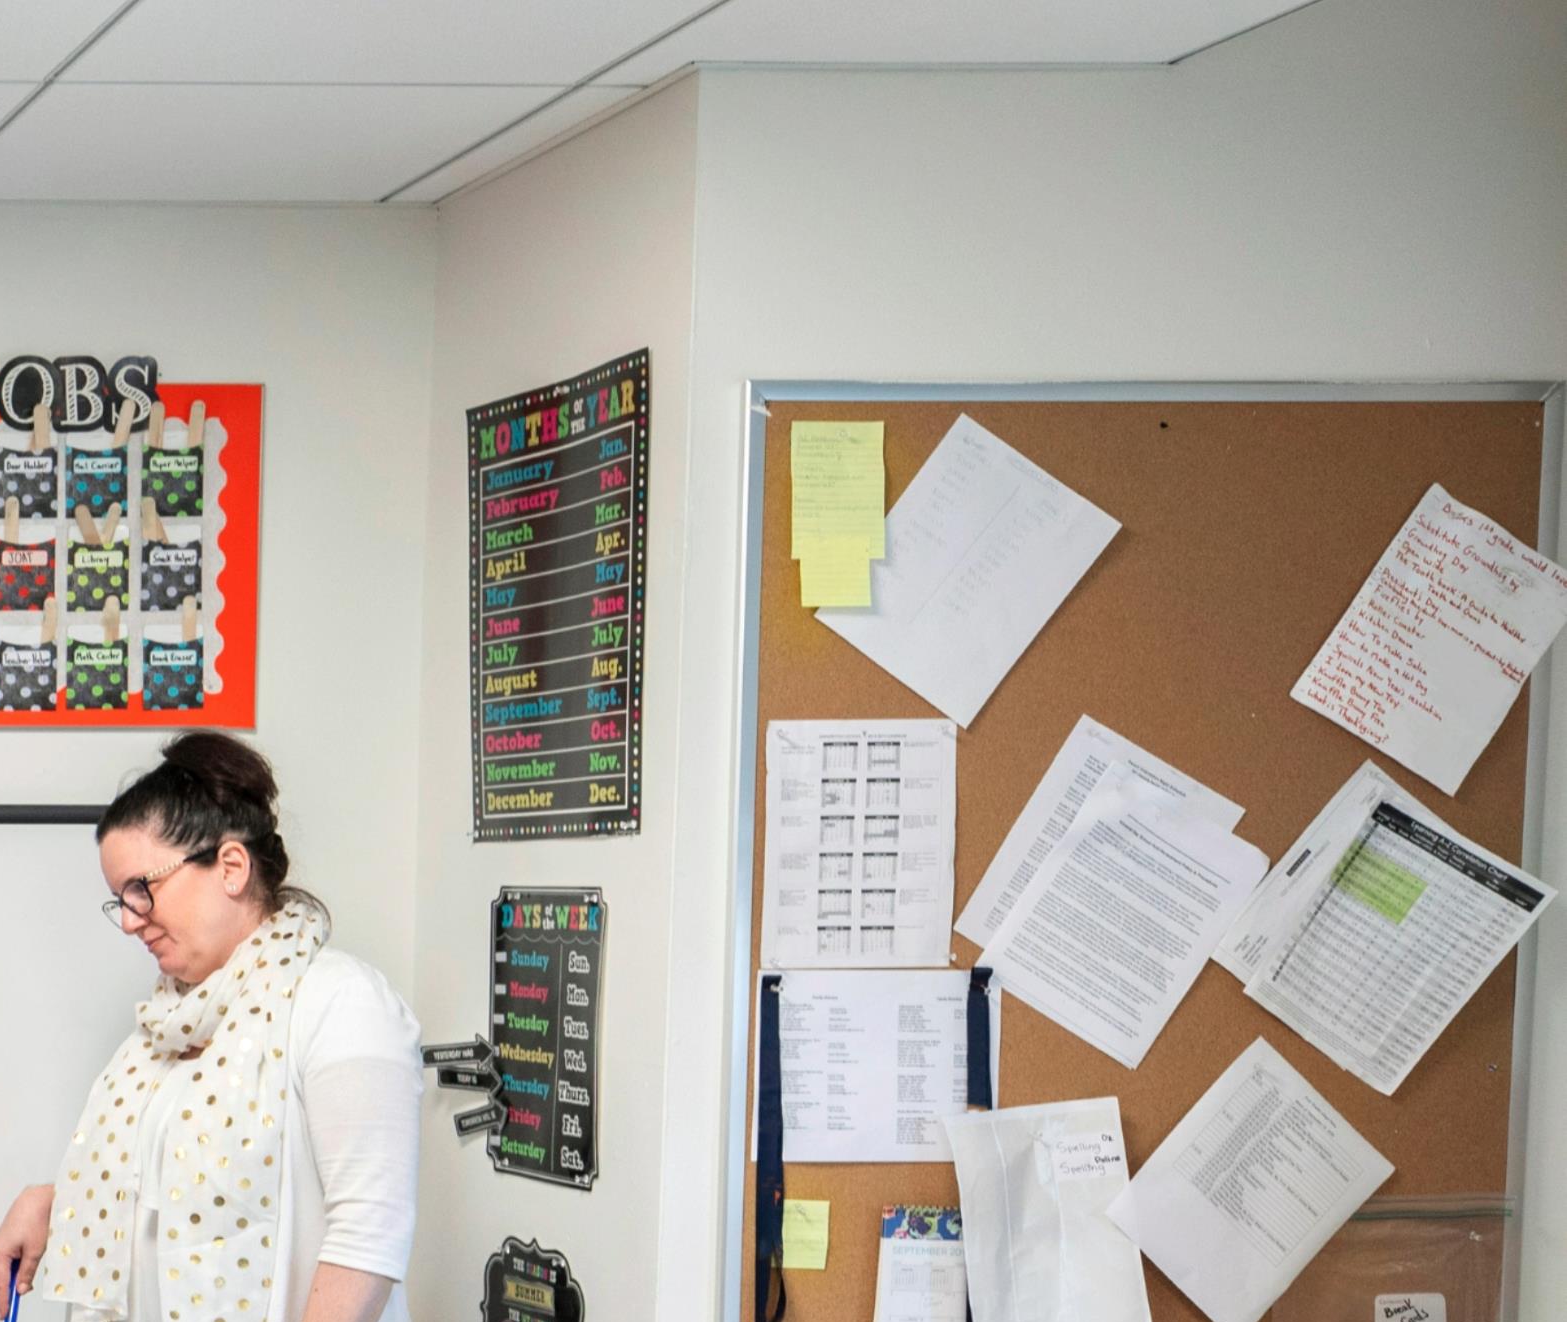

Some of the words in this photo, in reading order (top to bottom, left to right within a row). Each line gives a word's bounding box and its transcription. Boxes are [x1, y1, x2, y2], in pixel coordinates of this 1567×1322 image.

[480, 404, 569, 459] MONTHS
[570, 417, 586, 434] THE
[586, 381, 635, 425] YEAR
[486, 458, 554, 491] January
[599, 438, 628, 458] Jan.
[486, 489, 559, 520] February
[600, 467, 626, 489] Feb.
[486, 523, 533, 549] March
[486, 554, 526, 579] April
[486, 617, 519, 636] June
[592, 595, 624, 616] June
[486, 672, 537, 694] August
[486, 698, 562, 723] September
[486, 732, 541, 752] October
[486, 760, 555, 784] November
[487, 790, 553, 810] December
[501, 904, 541, 929] DAYS
[543, 916, 555, 930] the
[555, 905, 600, 931] WEEK
[511, 951, 549, 971] Sunday
[507, 1012, 549, 1035] Tuesday
[500, 1043, 555, 1069] Wednesday
[501, 1136, 546, 1164] Saturday
